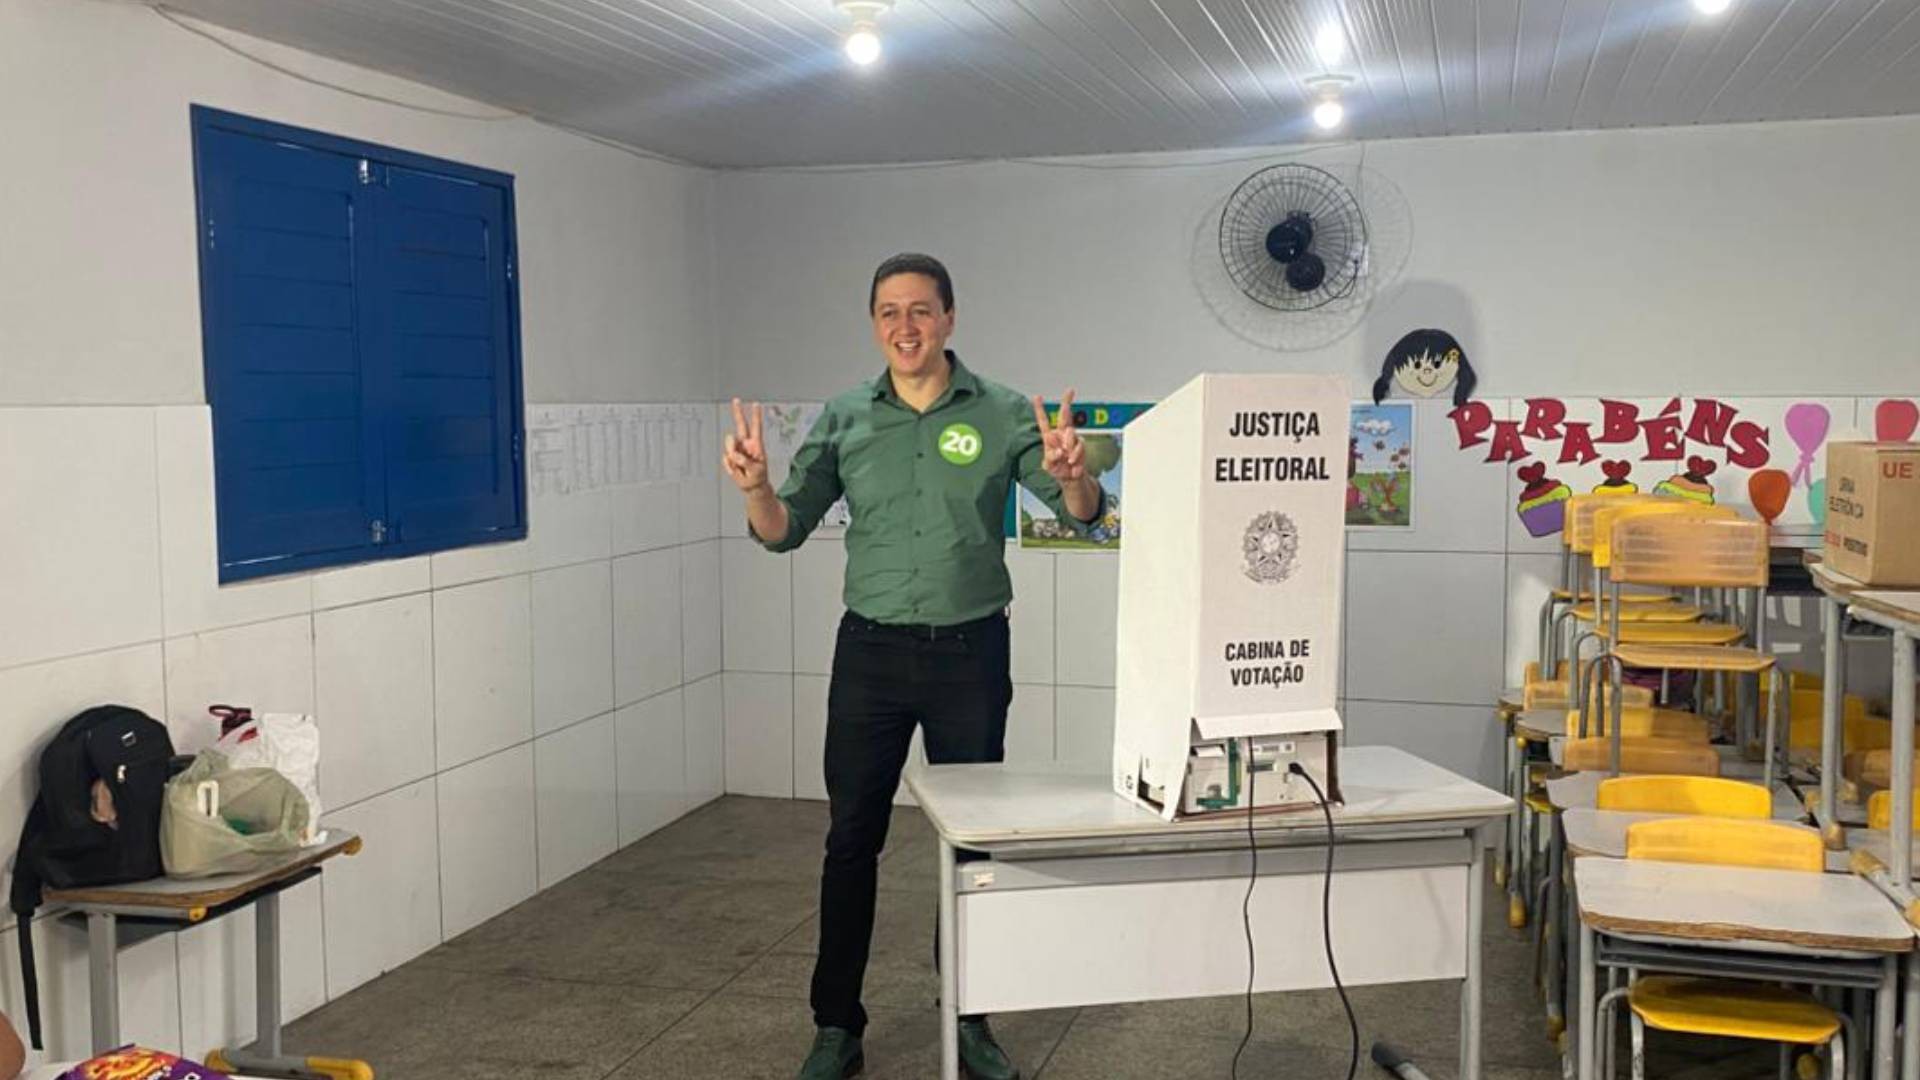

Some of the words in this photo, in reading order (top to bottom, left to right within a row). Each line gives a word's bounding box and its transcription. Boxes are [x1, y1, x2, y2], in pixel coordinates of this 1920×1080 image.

[1229, 412, 1320, 443] JUSTIÇA
[1447, 397, 1770, 468] PARABÉNS
[943, 430, 978, 456] 20
[1215, 457, 1330, 482] ELEITORAL
[1883, 461, 1913, 479] UE
[1225, 641, 1284, 661] CABINA
[1289, 639, 1310, 658] DE
[1230, 662, 1304, 687] VOTAÇÃO
